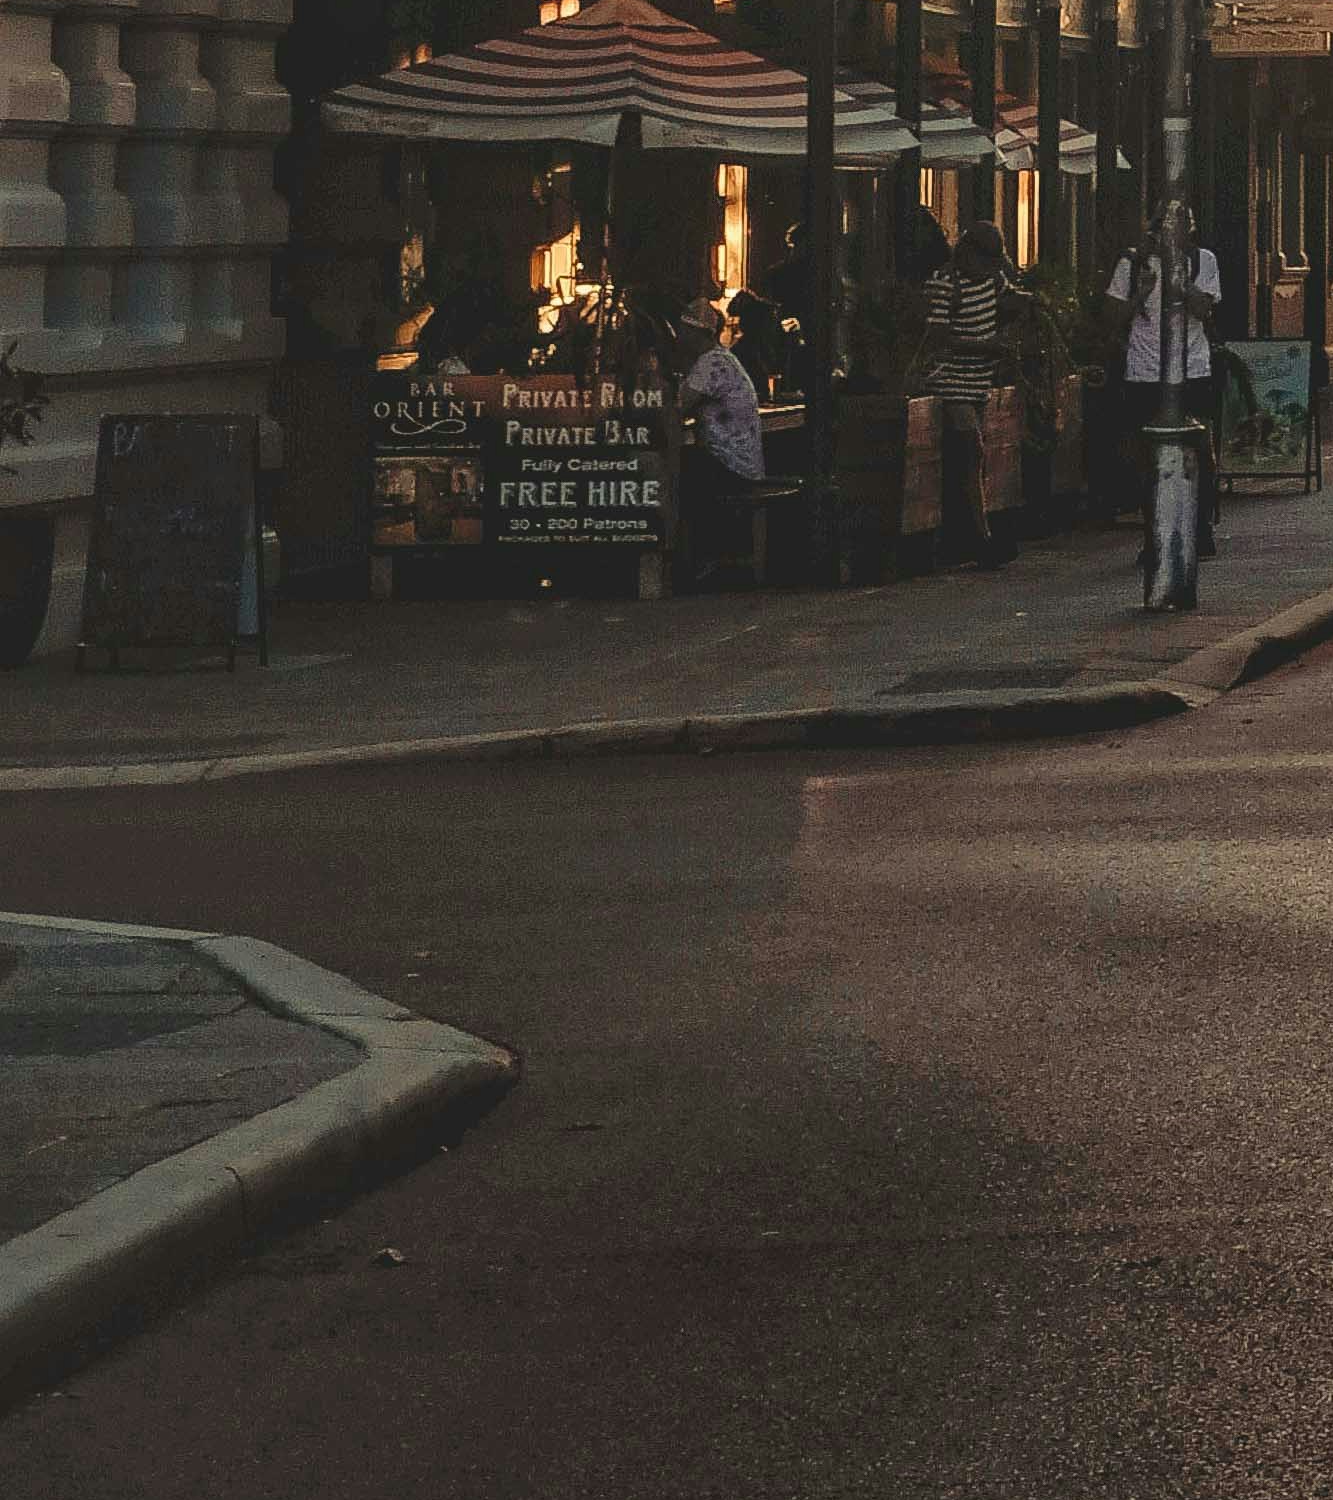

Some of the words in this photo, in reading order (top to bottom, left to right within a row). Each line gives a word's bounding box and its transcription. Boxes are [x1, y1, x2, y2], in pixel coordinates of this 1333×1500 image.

[411, 382, 455, 397] BAR
[503, 383, 593, 408] PRIVATE
[374, 401, 486, 424] ORIENT
[505, 420, 597, 446] PRIVATE
[605, 420, 650, 445] BAR
[521, 459, 562, 472] Fully
[567, 458, 639, 471] Catered
[500, 481, 577, 507] FREE
[588, 480, 661, 507] HIRE
[583, 518, 648, 530] Patrons
